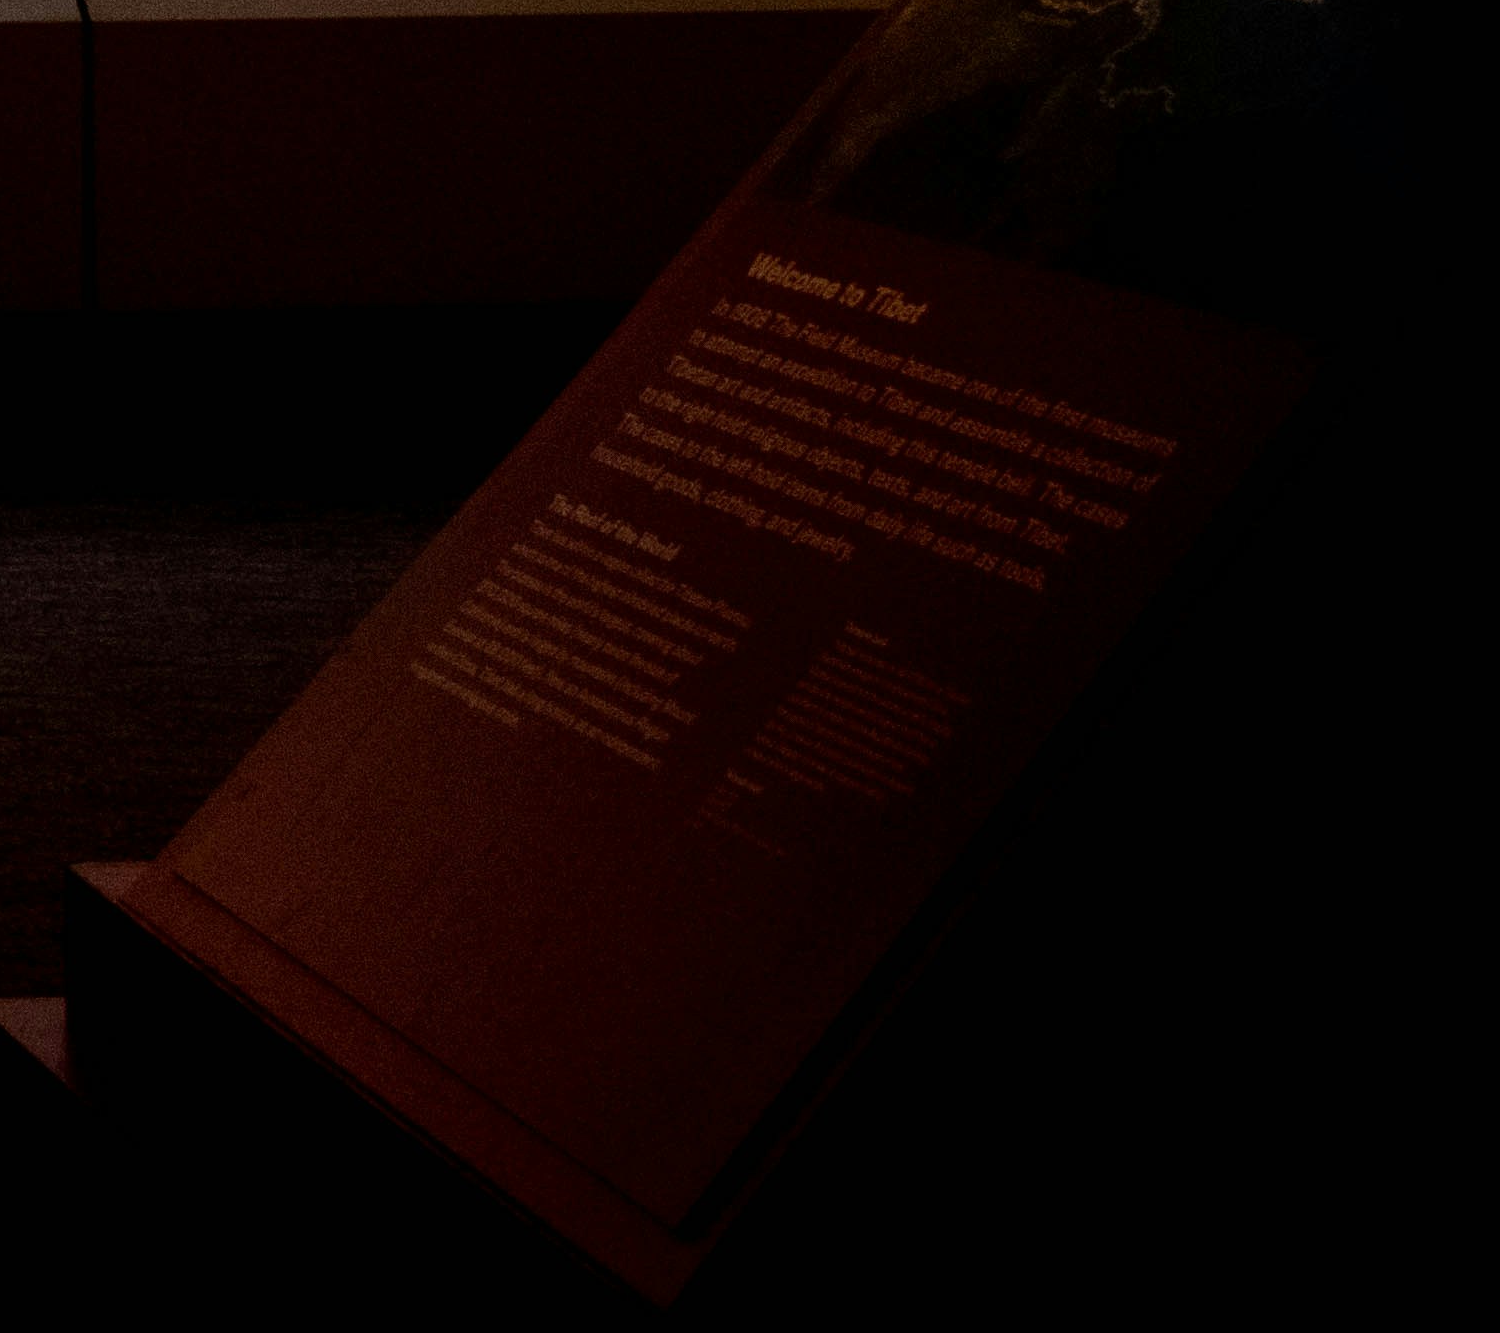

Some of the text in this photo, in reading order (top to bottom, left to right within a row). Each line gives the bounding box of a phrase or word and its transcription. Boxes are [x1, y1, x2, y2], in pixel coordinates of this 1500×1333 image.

[749, 254, 927, 323] Welcome to Tibet
